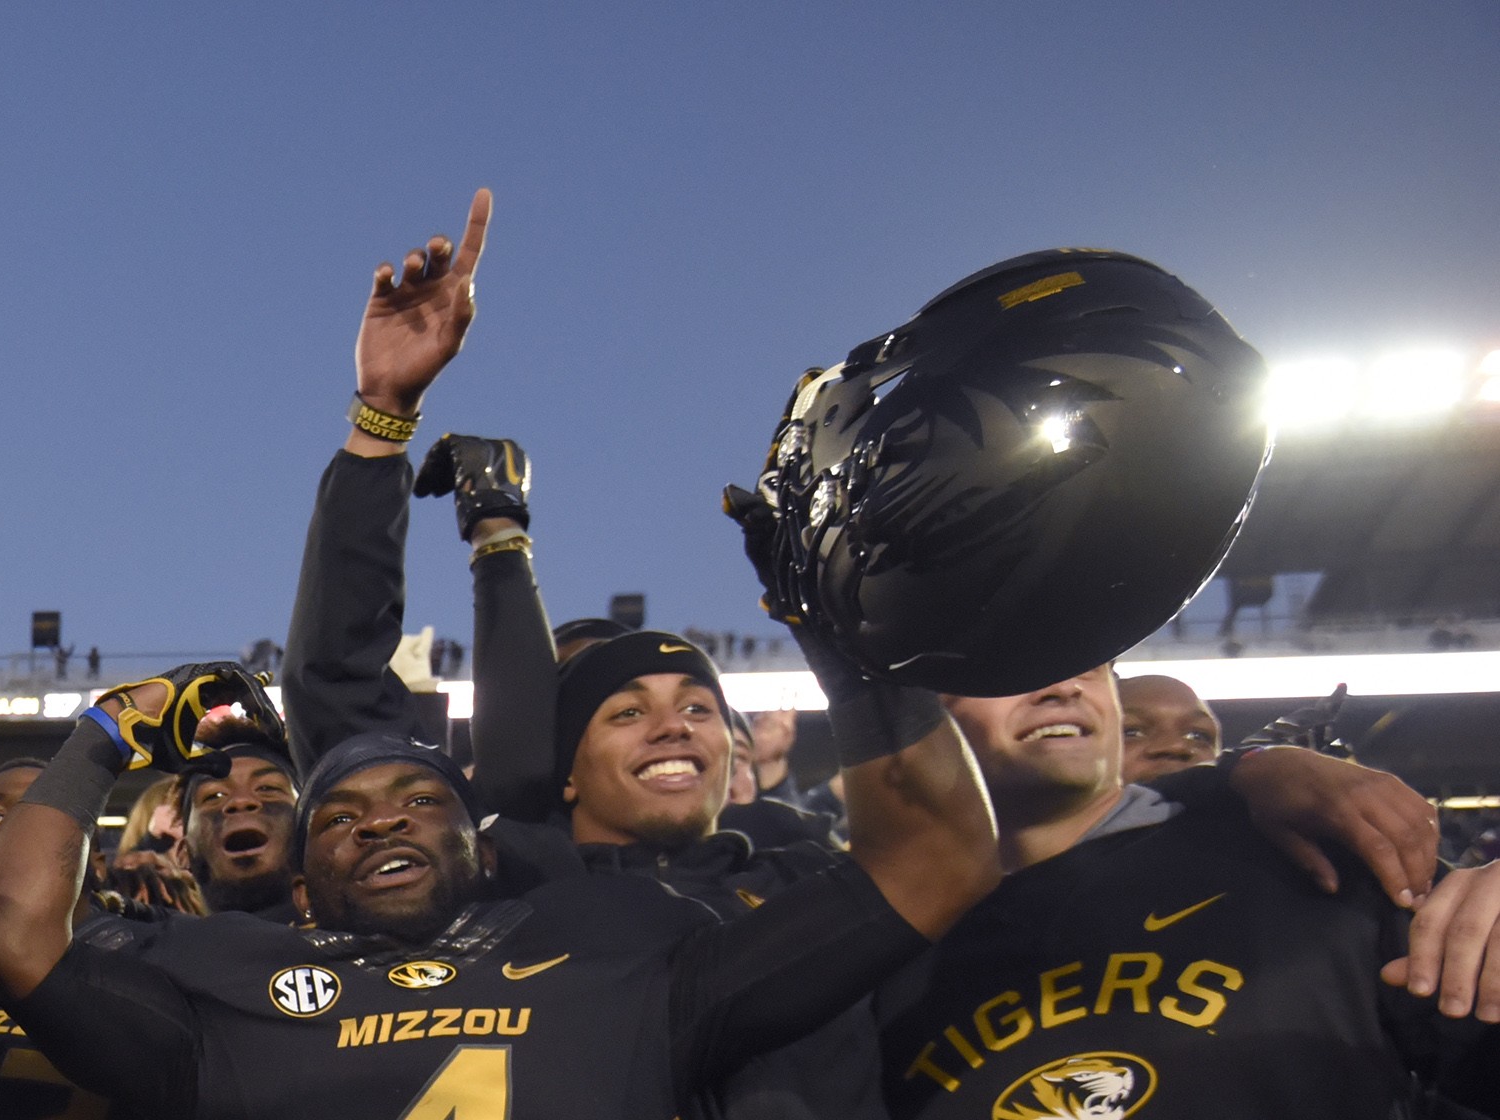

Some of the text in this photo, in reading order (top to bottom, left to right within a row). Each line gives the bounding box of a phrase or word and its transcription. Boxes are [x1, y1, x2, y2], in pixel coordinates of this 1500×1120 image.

[274, 969, 338, 1013] SEC
[338, 1007, 532, 1048] MIZZOU
[906, 951, 1244, 1093] TIGERS
